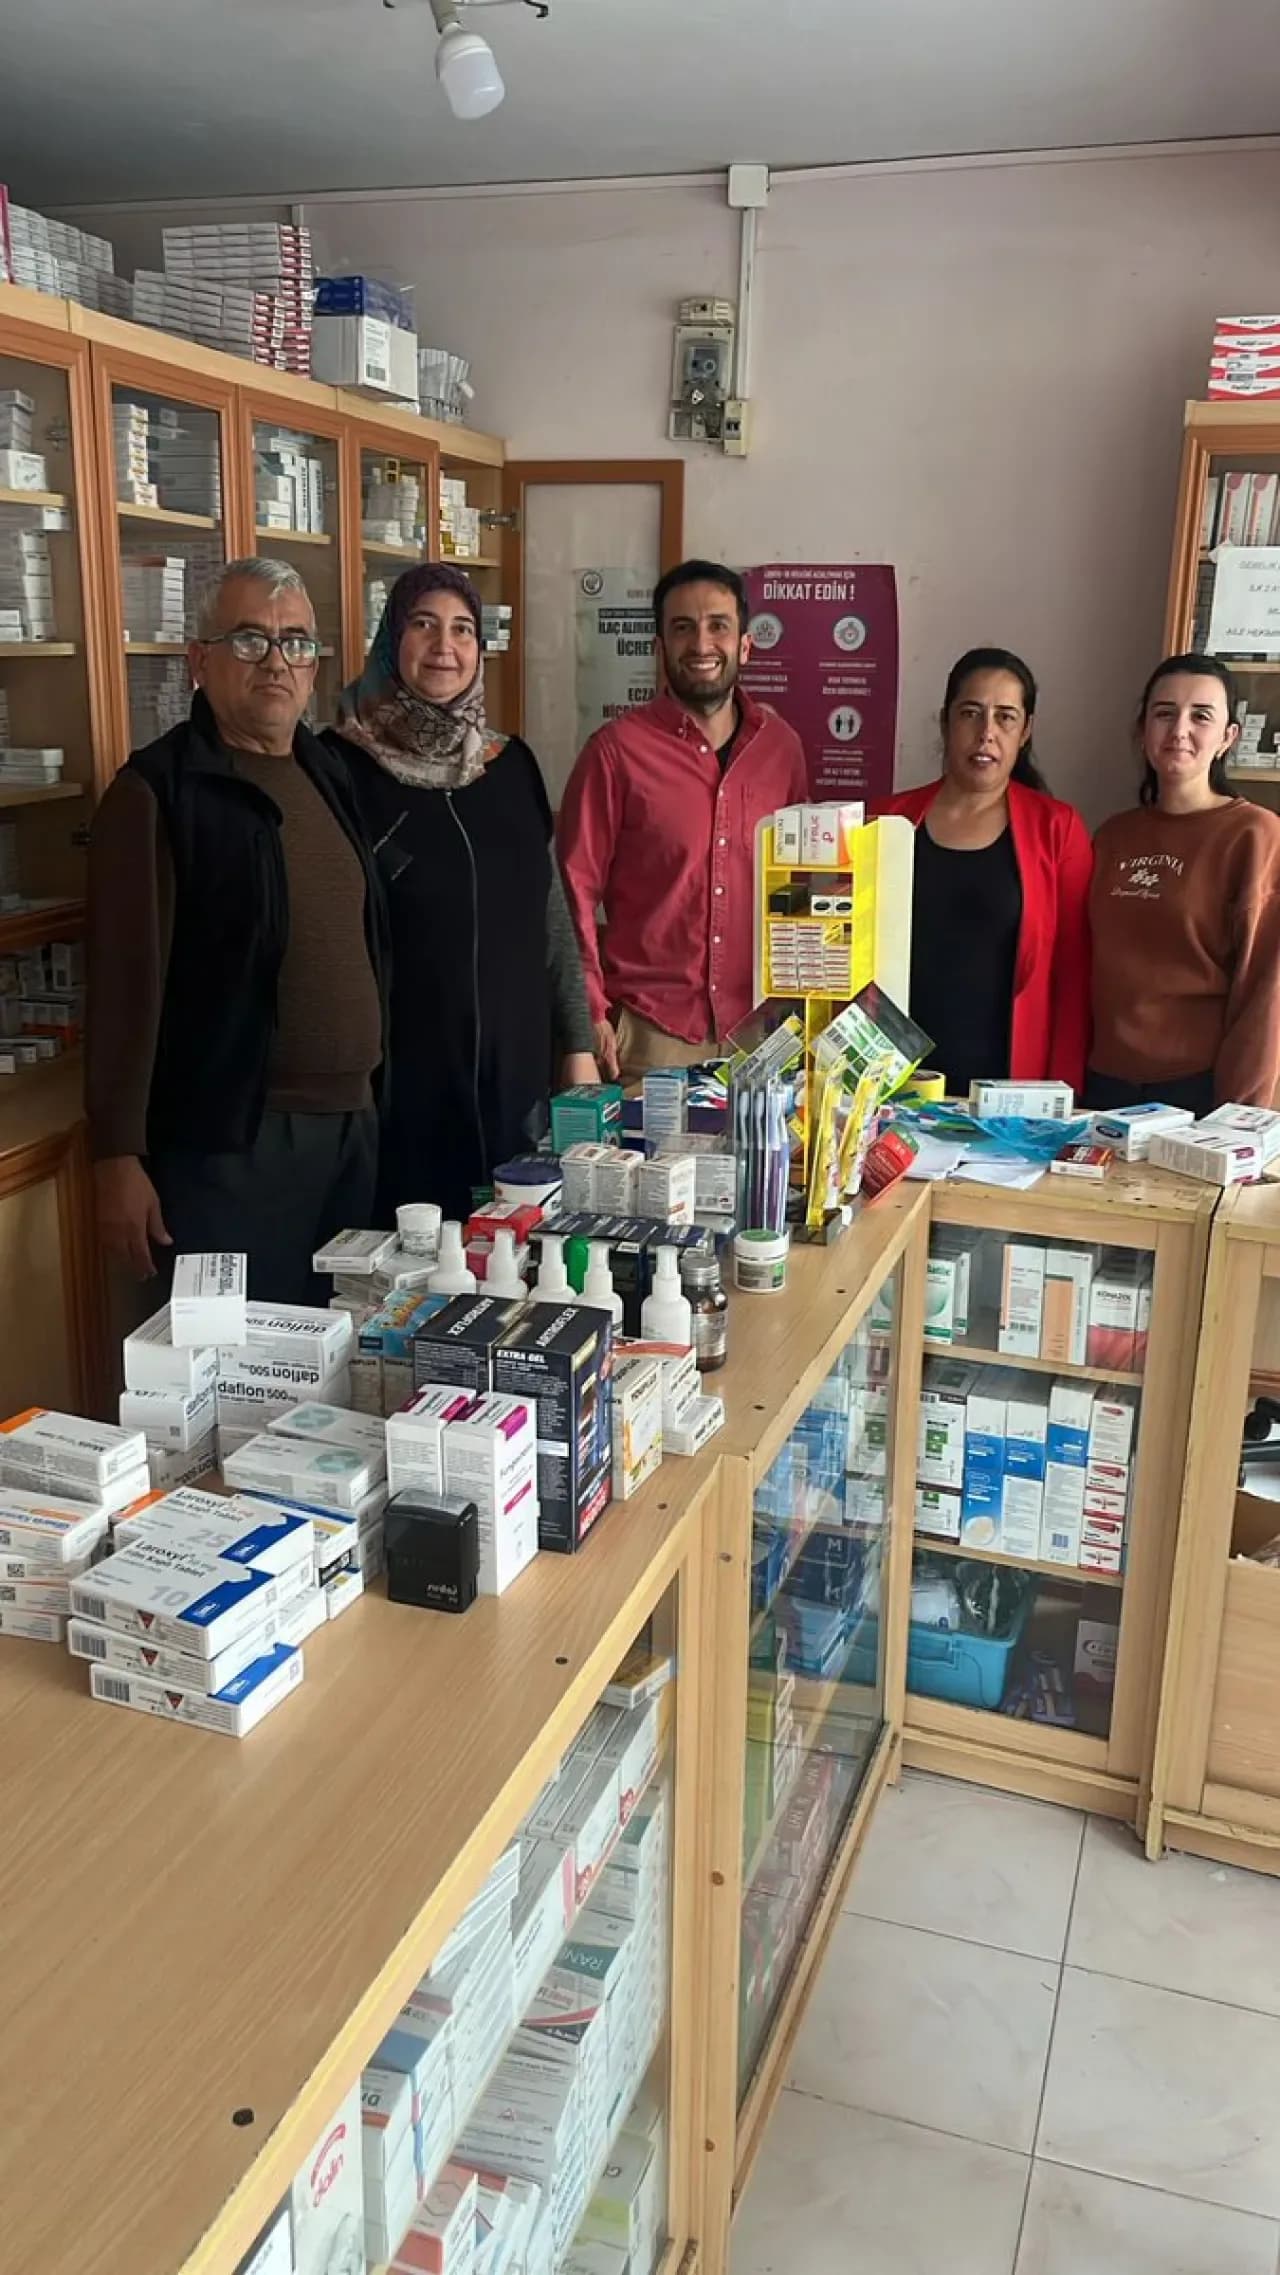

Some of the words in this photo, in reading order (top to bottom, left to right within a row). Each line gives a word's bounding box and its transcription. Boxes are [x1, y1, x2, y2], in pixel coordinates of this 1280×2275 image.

[763, 580, 811, 600] DİKKAT
[815, 580, 846, 600] EDİN
[496, 1349, 526, 1360] EXTRA
[528, 1351, 545, 1363] GEL
[272, 1366, 319, 1384] daflon
[217, 1381, 265, 1398] daflon
[136, 1541, 191, 1561] Laroxyl
[149, 1585, 190, 1606] 10
